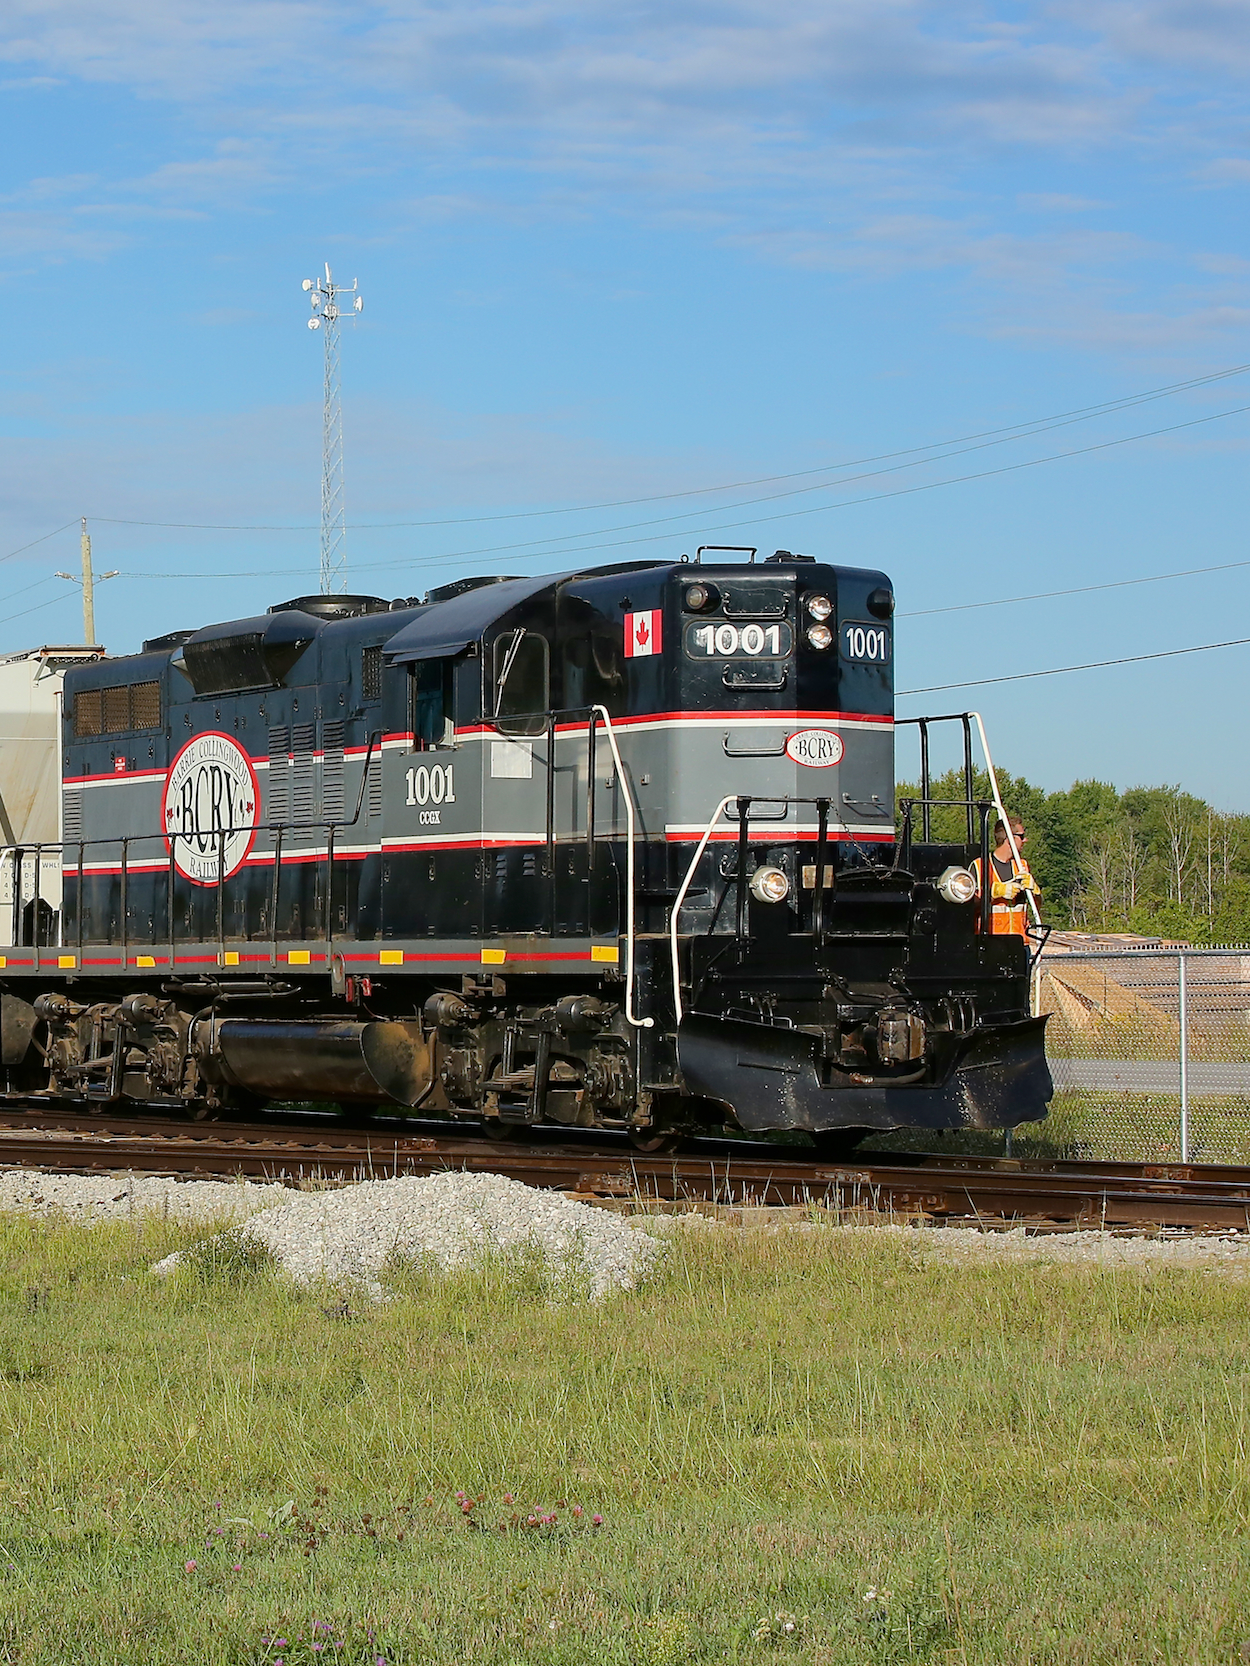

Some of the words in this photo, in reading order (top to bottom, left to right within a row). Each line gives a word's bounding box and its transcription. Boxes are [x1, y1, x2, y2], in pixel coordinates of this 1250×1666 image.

[700, 623, 780, 656] 1001
[846, 627, 885, 660] 1001
[799, 737, 836, 759] BCRY
[171, 746, 196, 791] BARRIE
[199, 740, 249, 786] COLLINGWOOD
[405, 763, 456, 806] 1001
[180, 765, 239, 853] BCRY
[418, 810, 441, 825] CCGX
[190, 854, 229, 878] RAILWY
